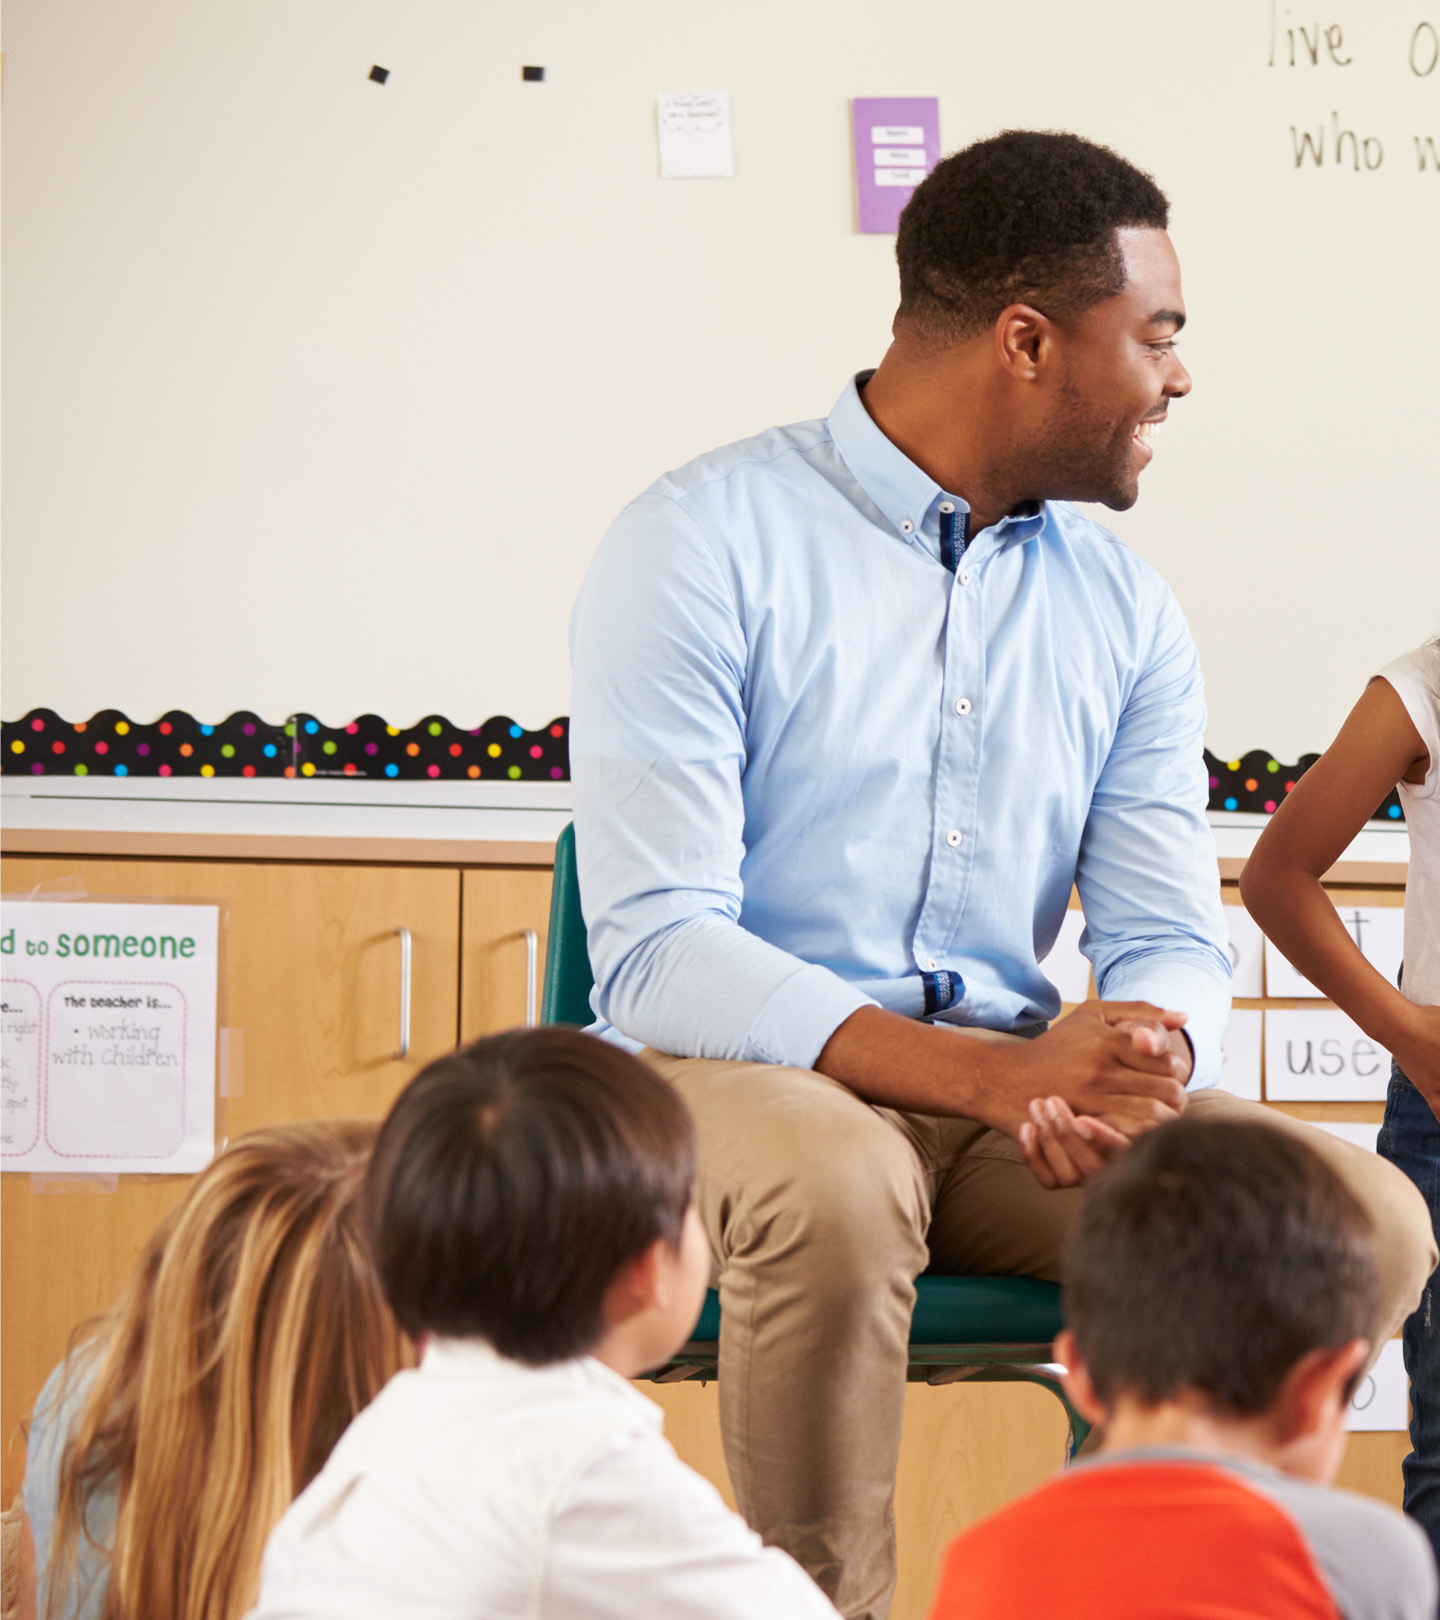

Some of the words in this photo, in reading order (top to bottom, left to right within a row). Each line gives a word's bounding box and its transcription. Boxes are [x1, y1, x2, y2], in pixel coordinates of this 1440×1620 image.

[1289, 110, 1384, 173] who
[25, 939, 49, 957] to
[55, 933, 196, 960] someone
[63, 995, 87, 1010] The
[89, 996, 143, 1009] teacher
[87, 1016, 160, 1055] working
[52, 1043, 95, 1067] with
[1285, 1036, 1382, 1078] use
